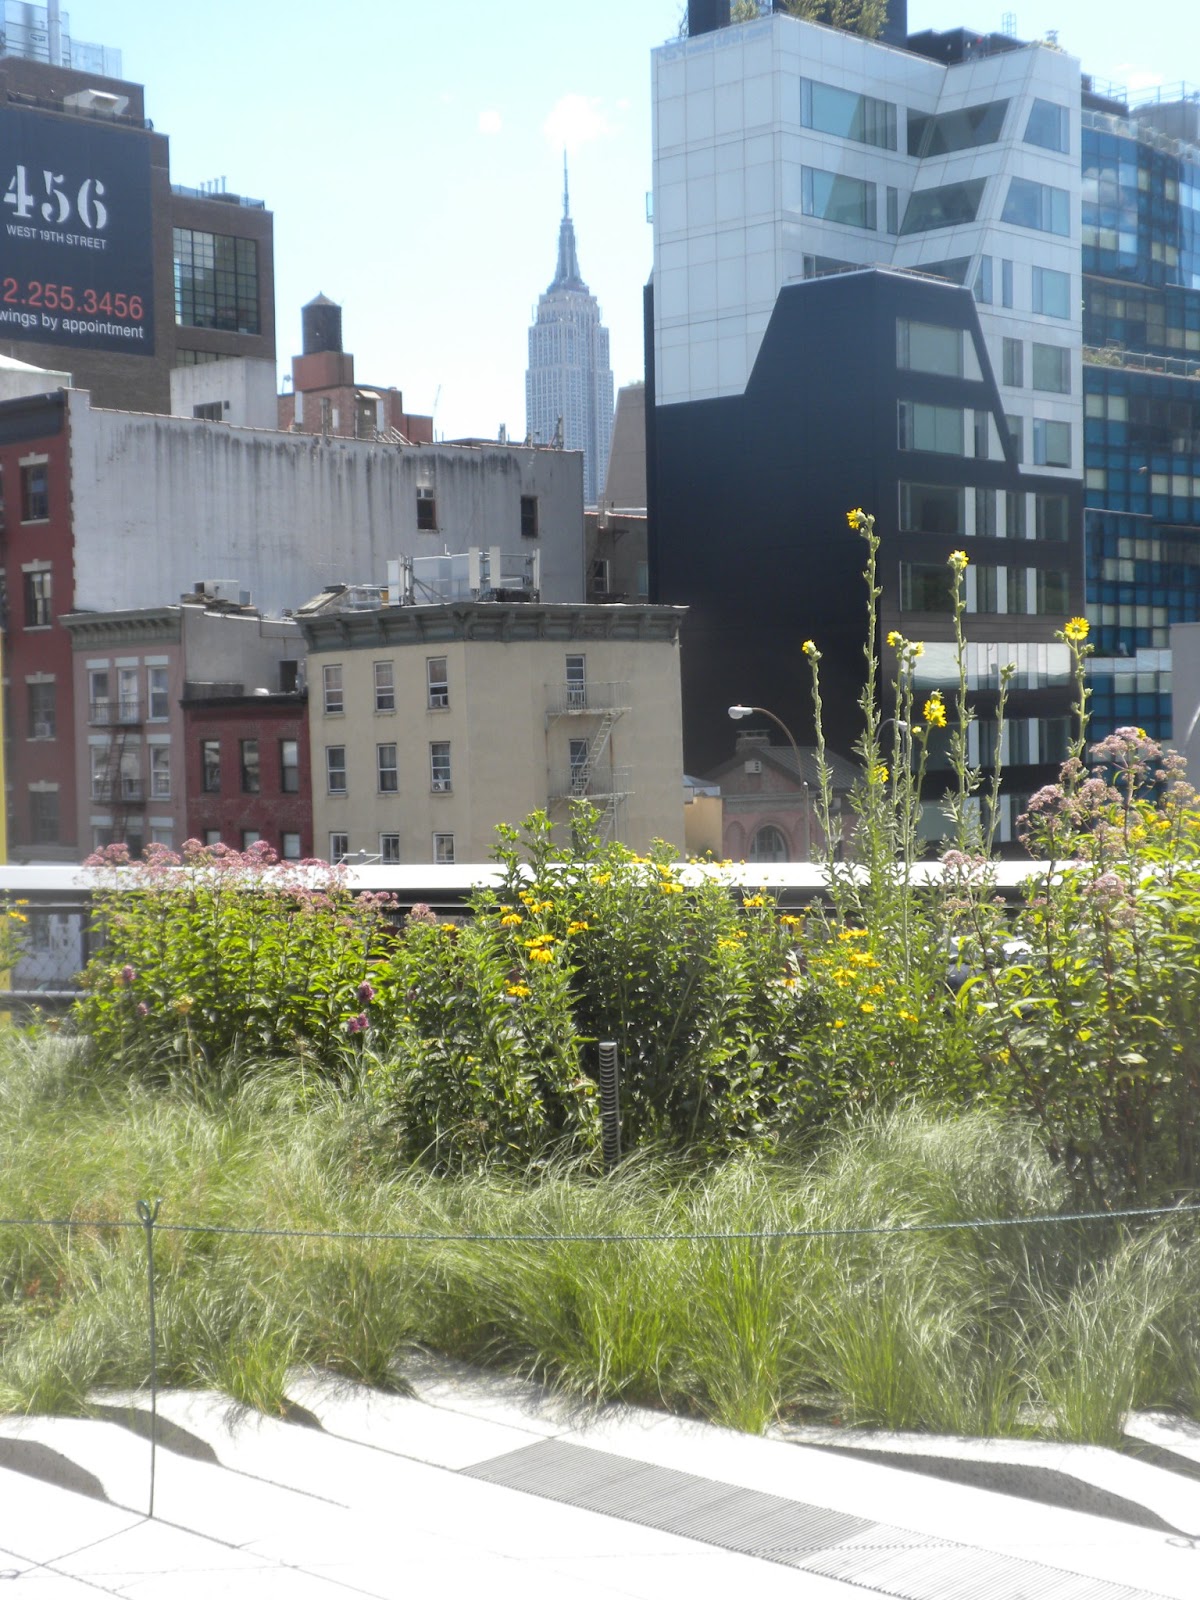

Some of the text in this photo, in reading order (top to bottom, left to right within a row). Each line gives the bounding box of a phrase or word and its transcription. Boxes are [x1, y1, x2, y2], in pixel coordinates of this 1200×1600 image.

[3, 165, 107, 229] 456
[6, 224, 107, 250] WEST 19TH STREET
[3, 277, 144, 319] 2.255.3456
[41, 312, 58, 331] by
[62, 318, 144, 339] appointment
